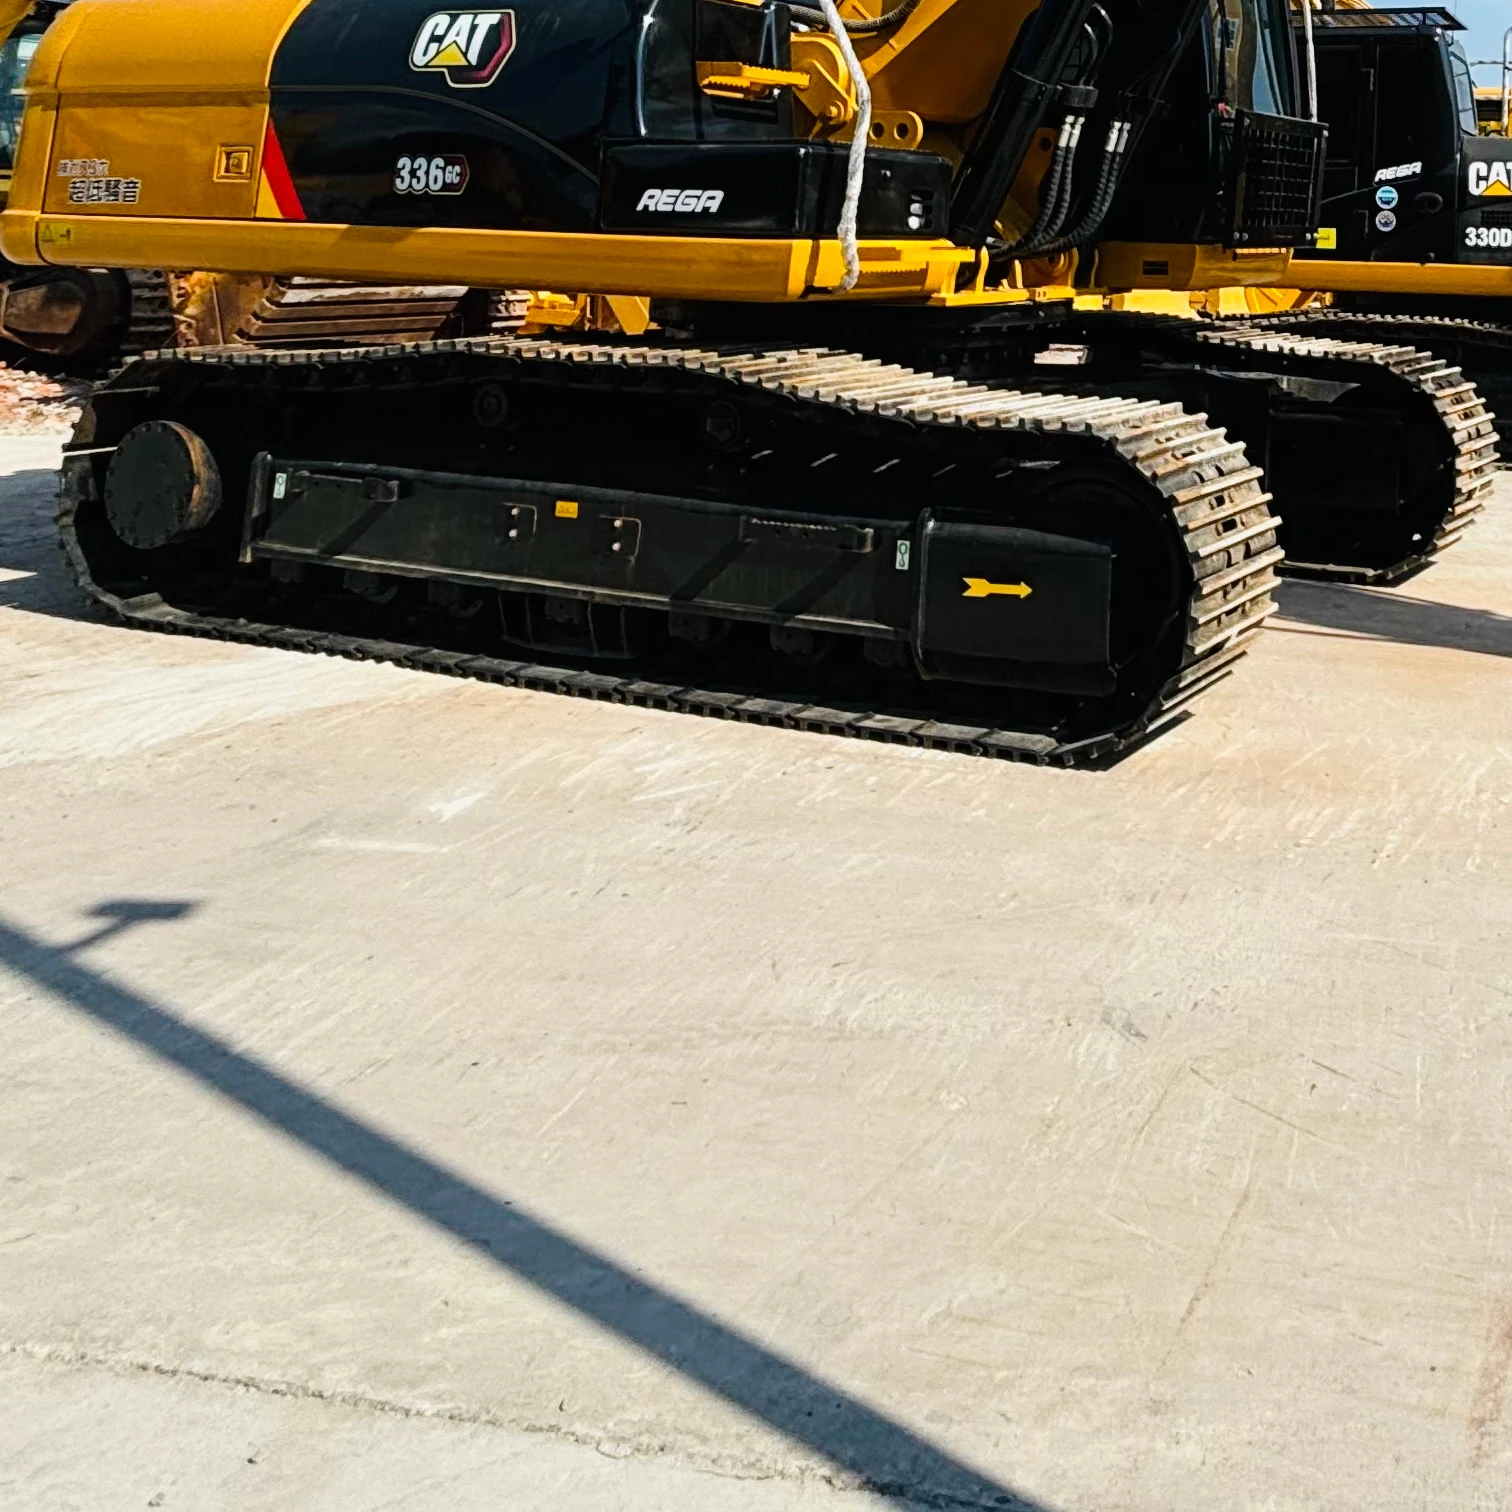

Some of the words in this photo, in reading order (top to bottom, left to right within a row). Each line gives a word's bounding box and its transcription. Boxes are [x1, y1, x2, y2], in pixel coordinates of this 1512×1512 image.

[412, 13, 502, 67] CAT
[1374, 160, 1423, 183] REGA
[635, 188, 725, 213] REGA
